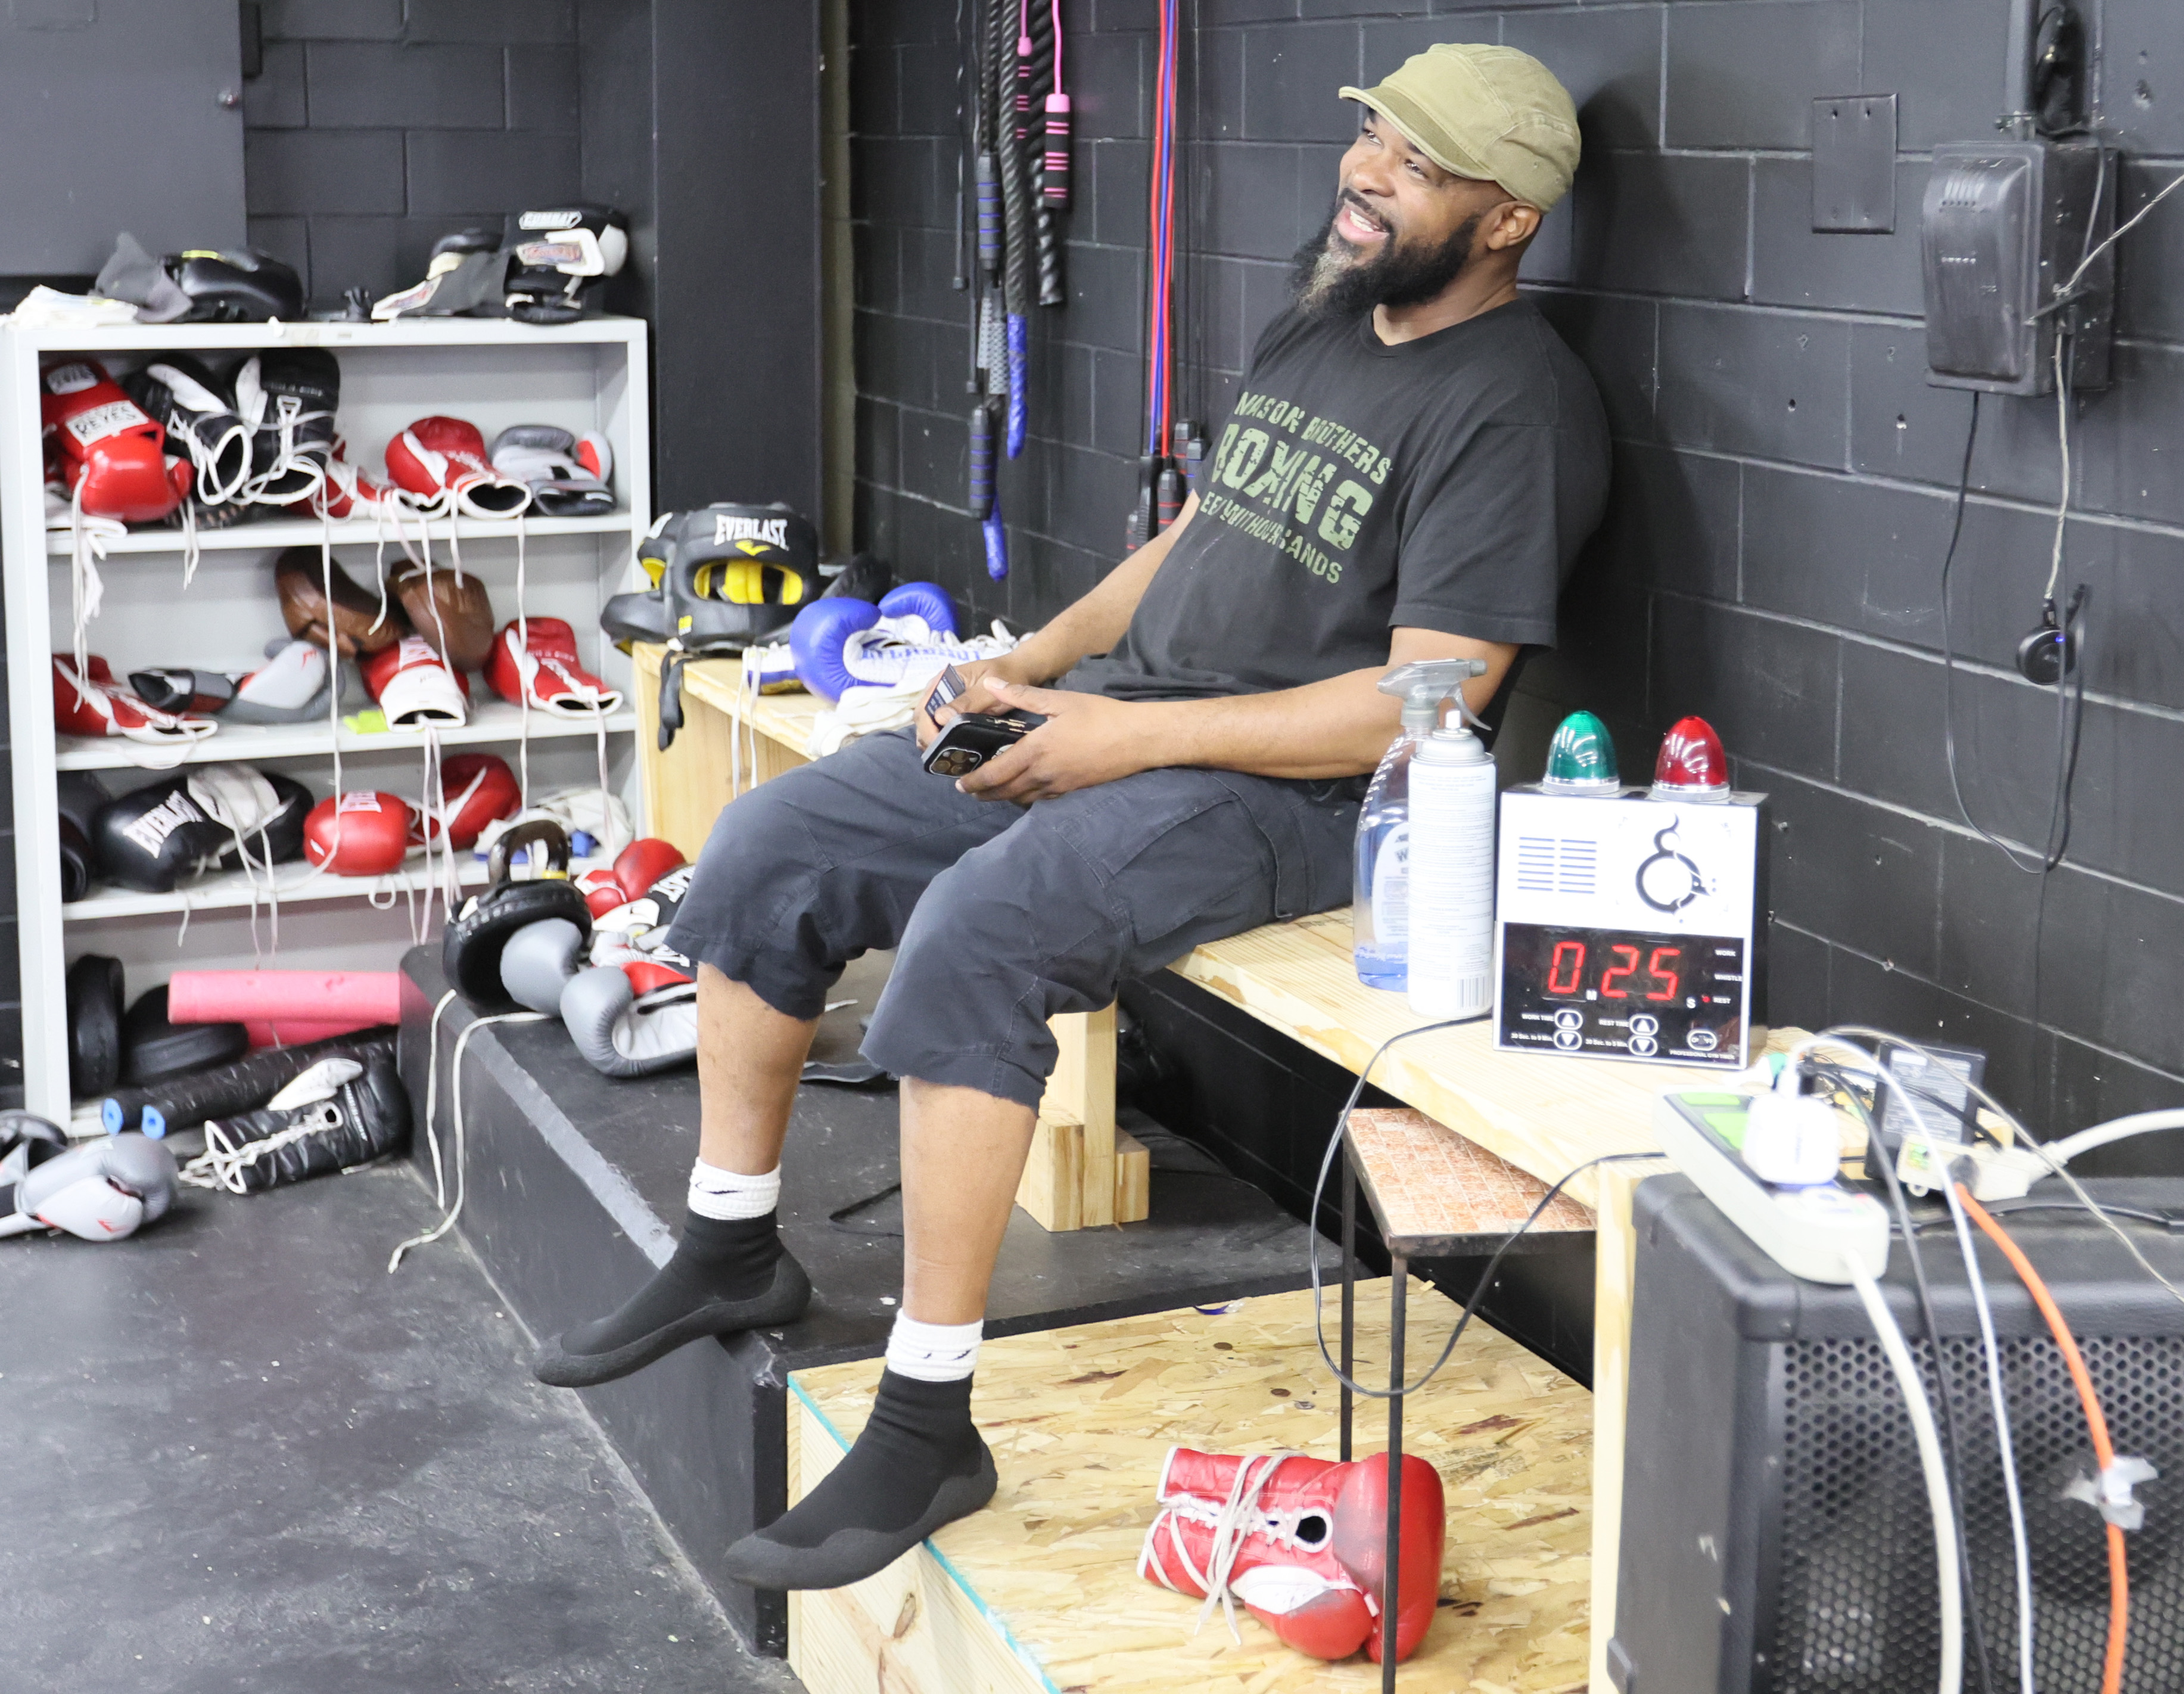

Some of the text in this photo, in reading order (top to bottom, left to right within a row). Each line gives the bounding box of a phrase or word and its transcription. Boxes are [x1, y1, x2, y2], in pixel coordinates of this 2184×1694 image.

[714, 514, 789, 551] EVERLAST
[122, 790, 203, 859] EVERLAST
[1547, 941, 1681, 1002] 0 25
[1714, 973, 1743, 982] WHISTLE
[1586, 990, 1597, 1001] M
[1686, 997, 1696, 1009] S
